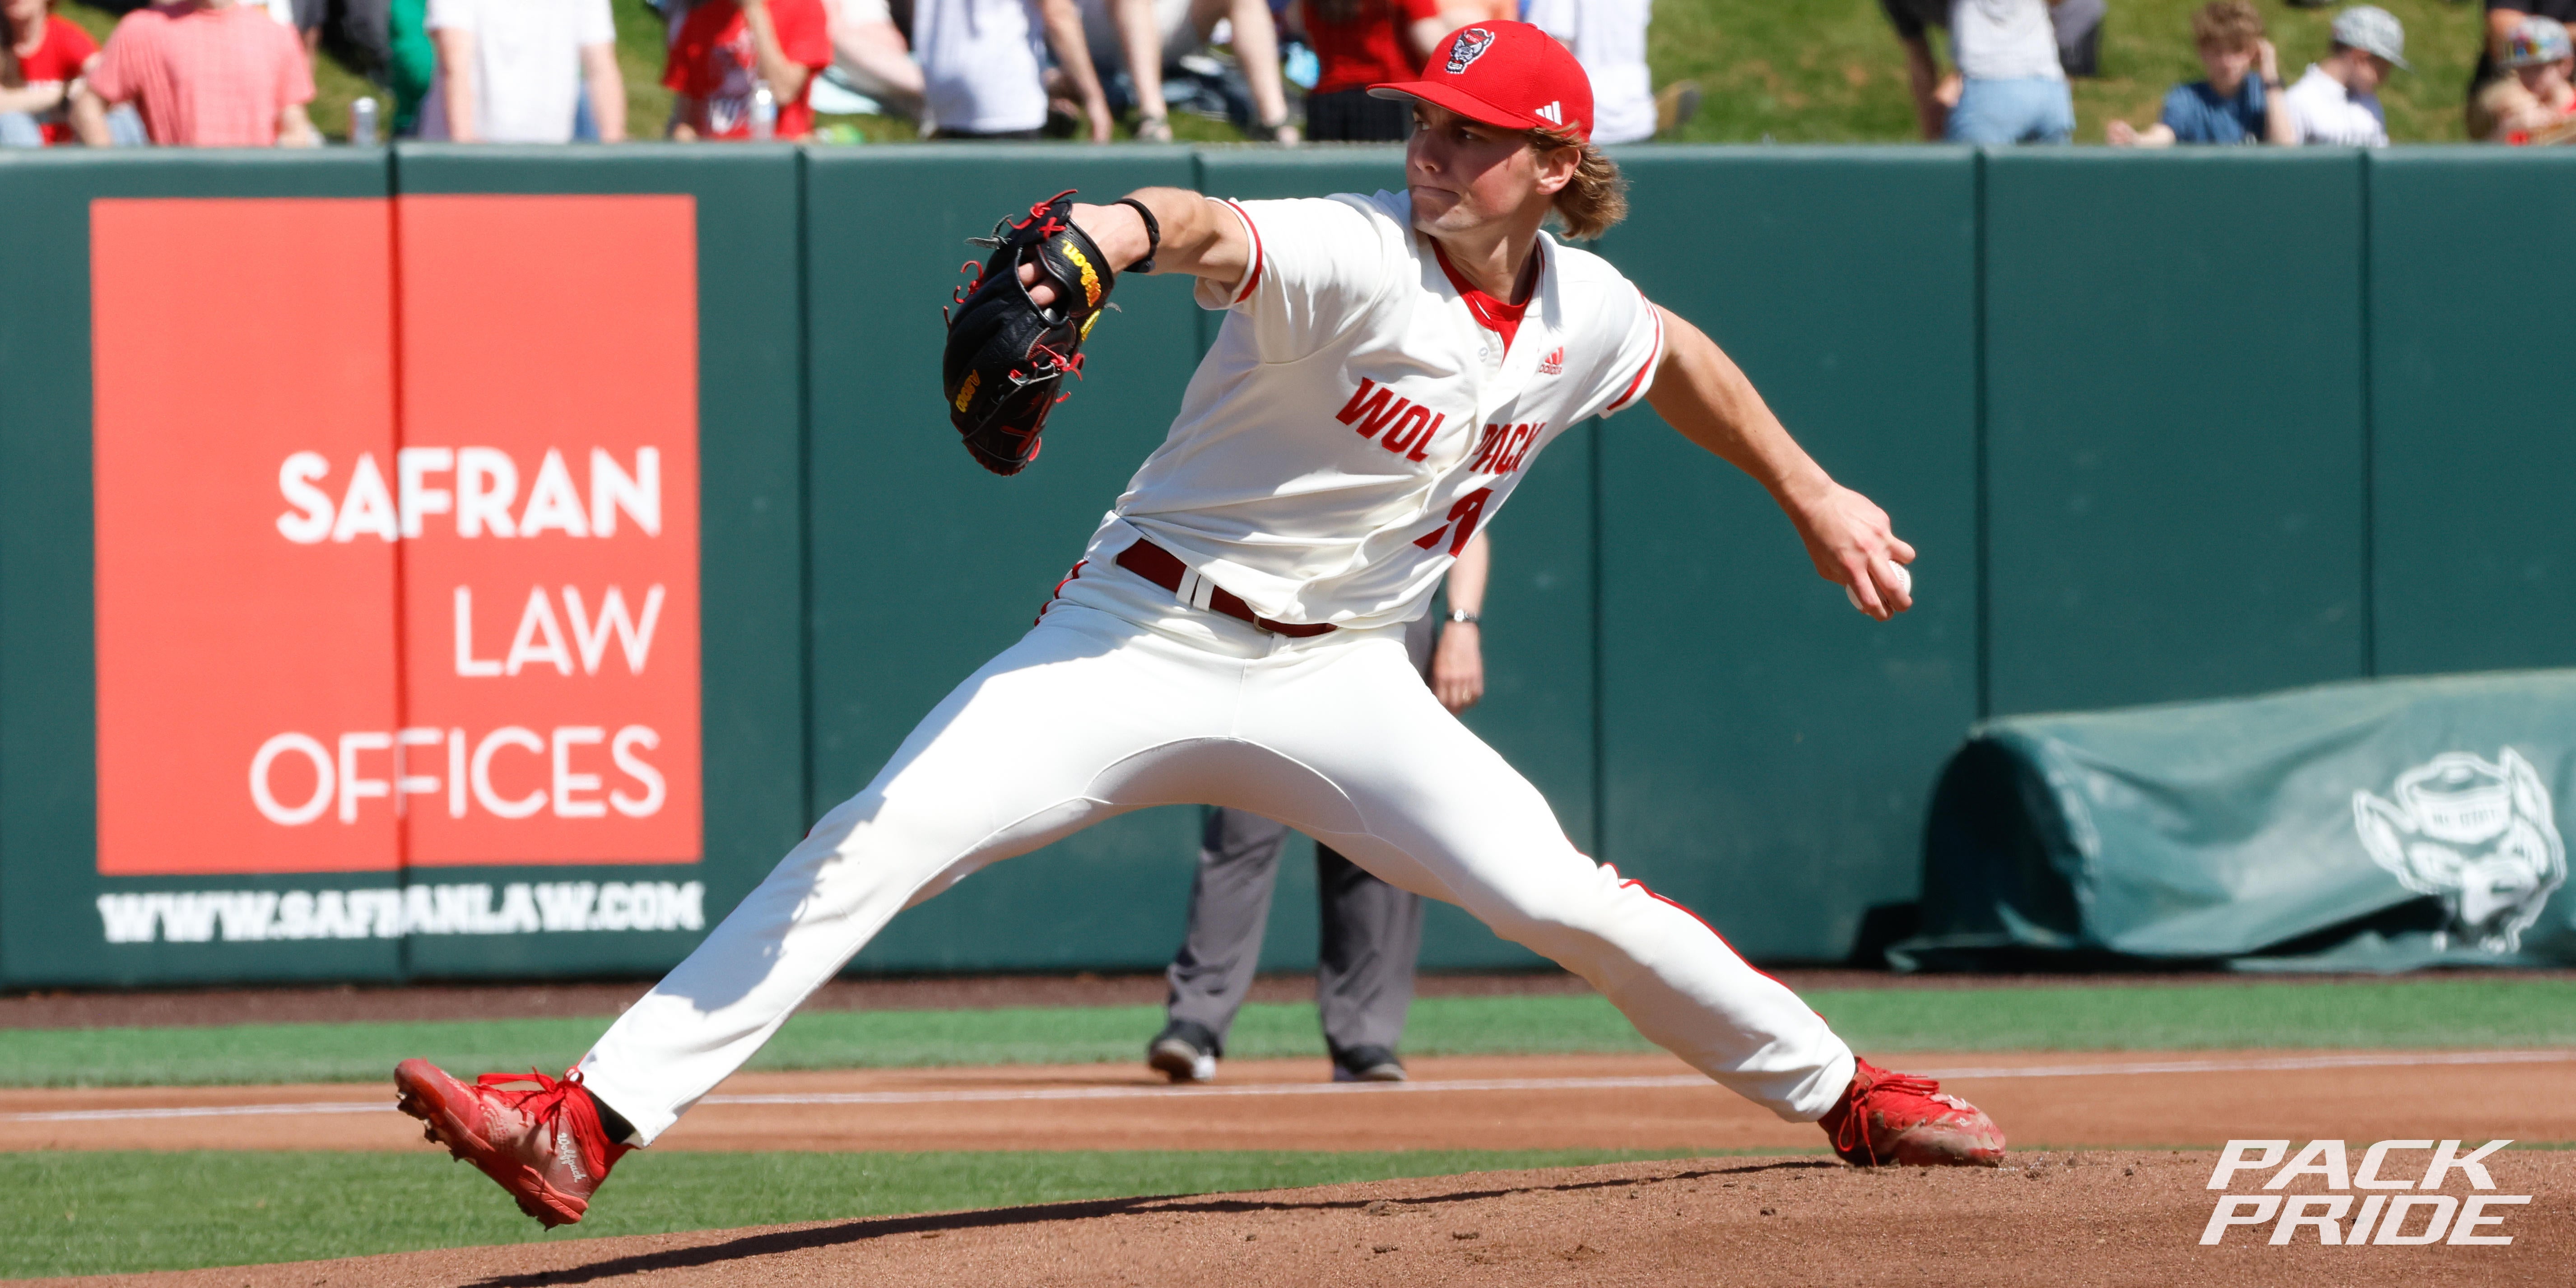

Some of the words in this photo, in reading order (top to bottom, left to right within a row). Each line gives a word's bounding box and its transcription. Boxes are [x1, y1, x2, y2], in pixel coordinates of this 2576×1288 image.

[276, 446, 661, 544] SAFRAN
[454, 585, 665, 677] LAW
[248, 725, 666, 826] OFFICES
[96, 880, 705, 943] WWW.SAFRANLAW.COM
[557, 1131, 587, 1183] Wolfpack
